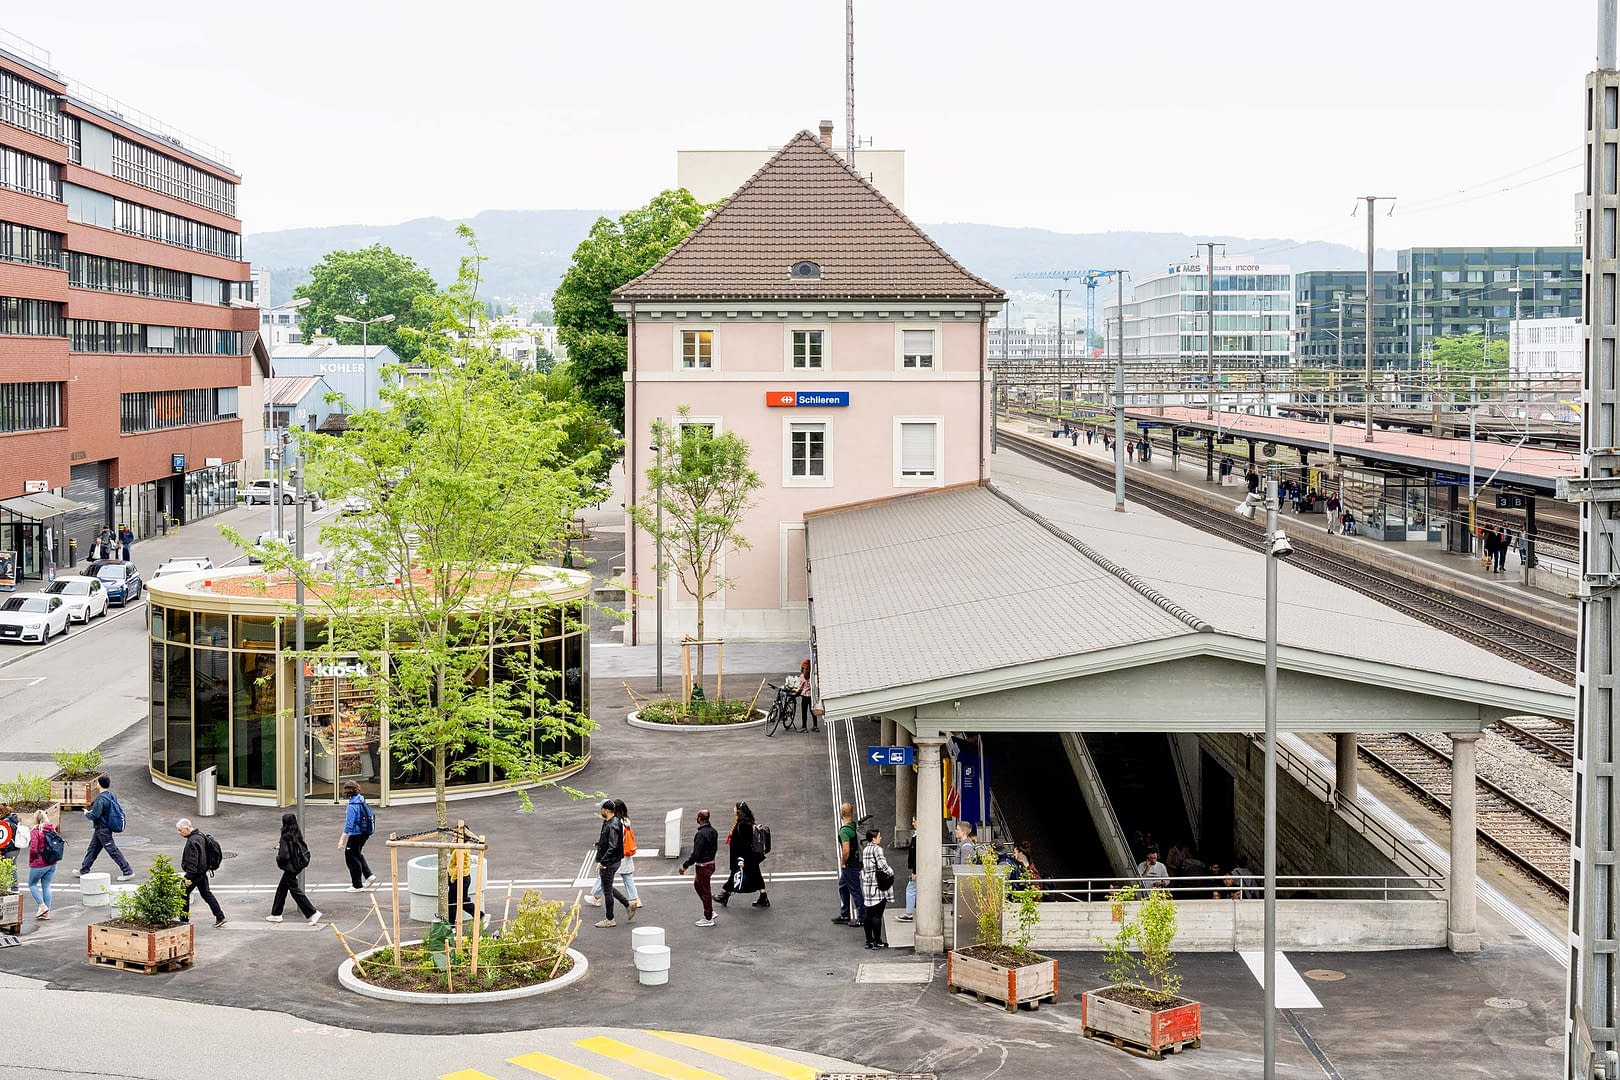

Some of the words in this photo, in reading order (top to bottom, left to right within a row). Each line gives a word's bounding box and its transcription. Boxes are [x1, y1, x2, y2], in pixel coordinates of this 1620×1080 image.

[320, 363, 366, 373] KOHLER
[798, 395, 841, 404] Schlieren
[1500, 498, 1507, 506] 3
